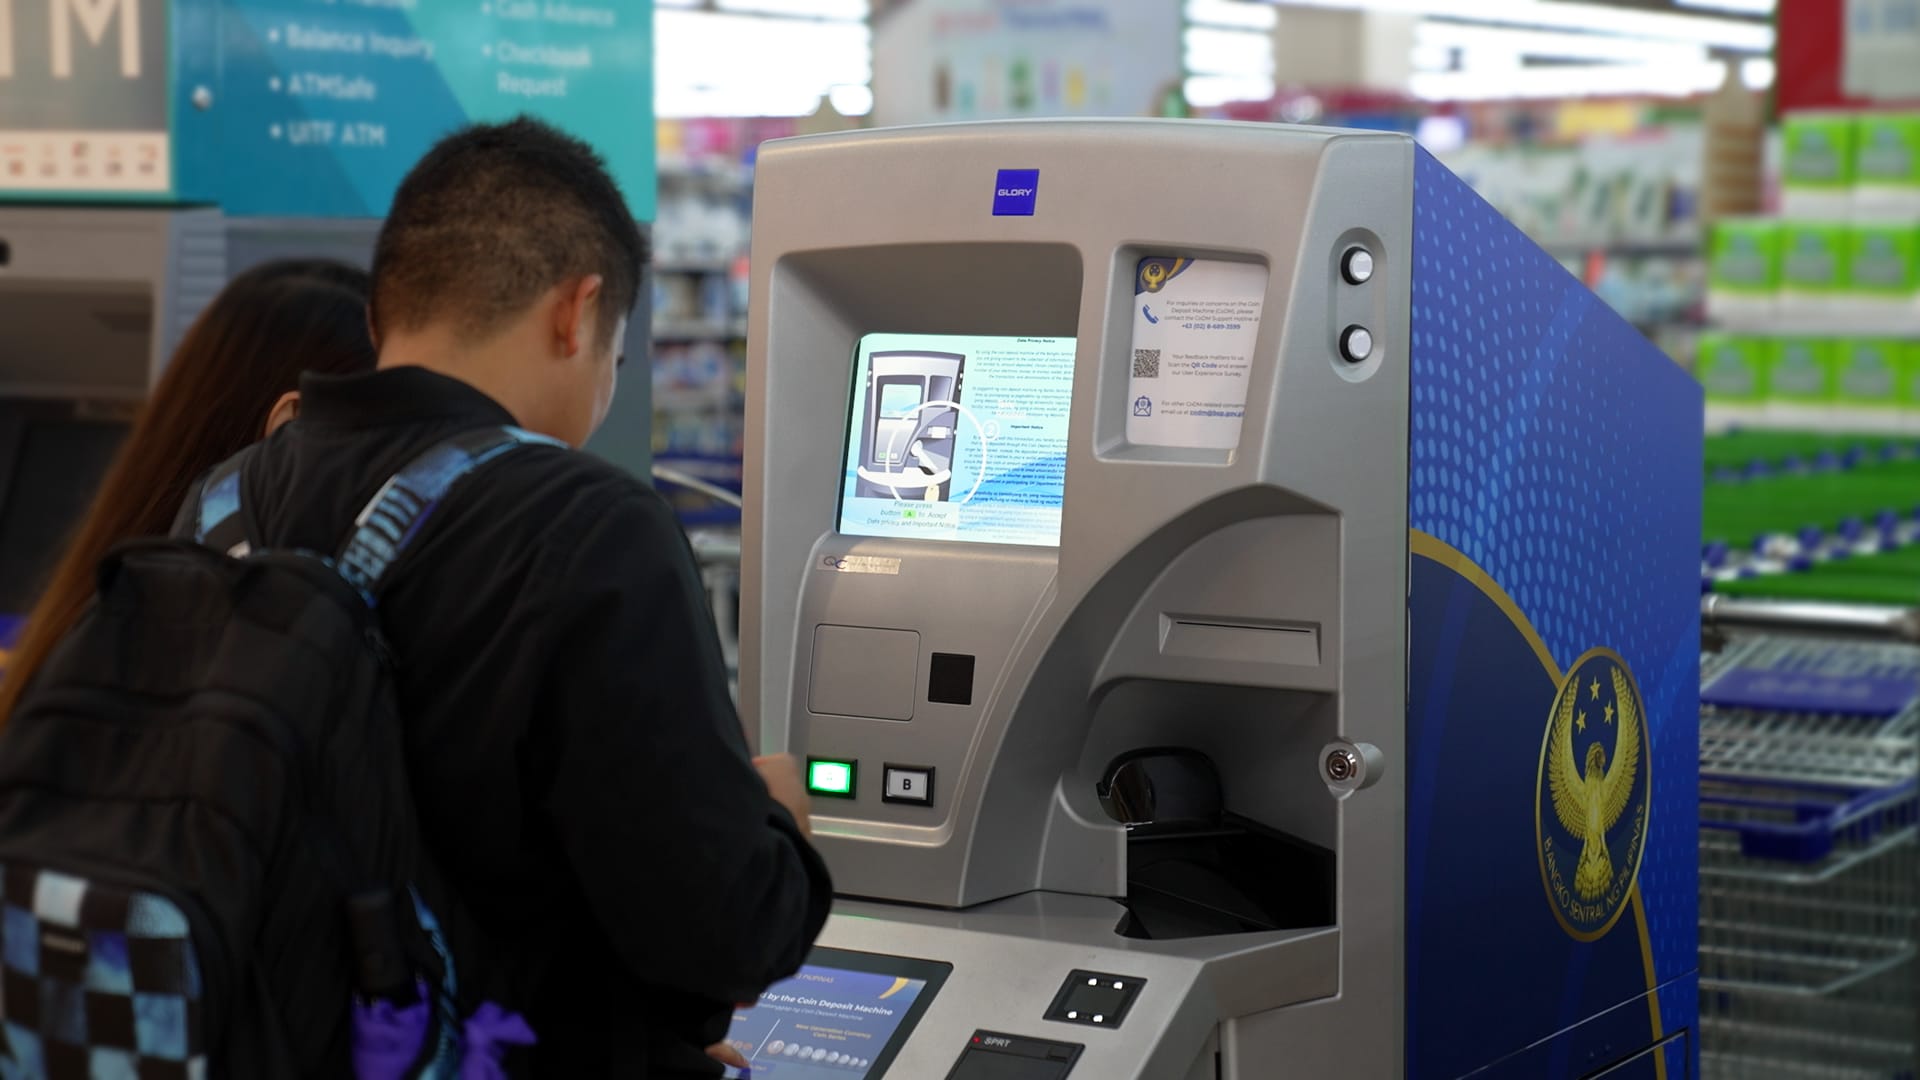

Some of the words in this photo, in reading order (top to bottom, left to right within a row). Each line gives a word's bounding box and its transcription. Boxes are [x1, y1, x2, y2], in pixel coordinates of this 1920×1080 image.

[287, 23, 364, 52] Balance
[369, 32, 435, 60] Inquiry
[289, 72, 376, 100] ATMSafe
[497, 71, 567, 98] Request
[341, 122, 386, 147] ATM
[998, 188, 1033, 197] GLORY
[903, 778, 912, 791] B
[1544, 836, 1570, 908] BANGKO
[1569, 899, 1606, 923] SENTRAL
[1606, 883, 1620, 911] NG
[1619, 804, 1644, 887] PILIPINAS
[768, 992, 780, 1003] by
[781, 994, 796, 1003] the
[797, 996, 817, 1006] Coin
[819, 999, 853, 1012] Deposit
[855, 1003, 893, 1017] Machine
[984, 1036, 1012, 1048] SPRT
